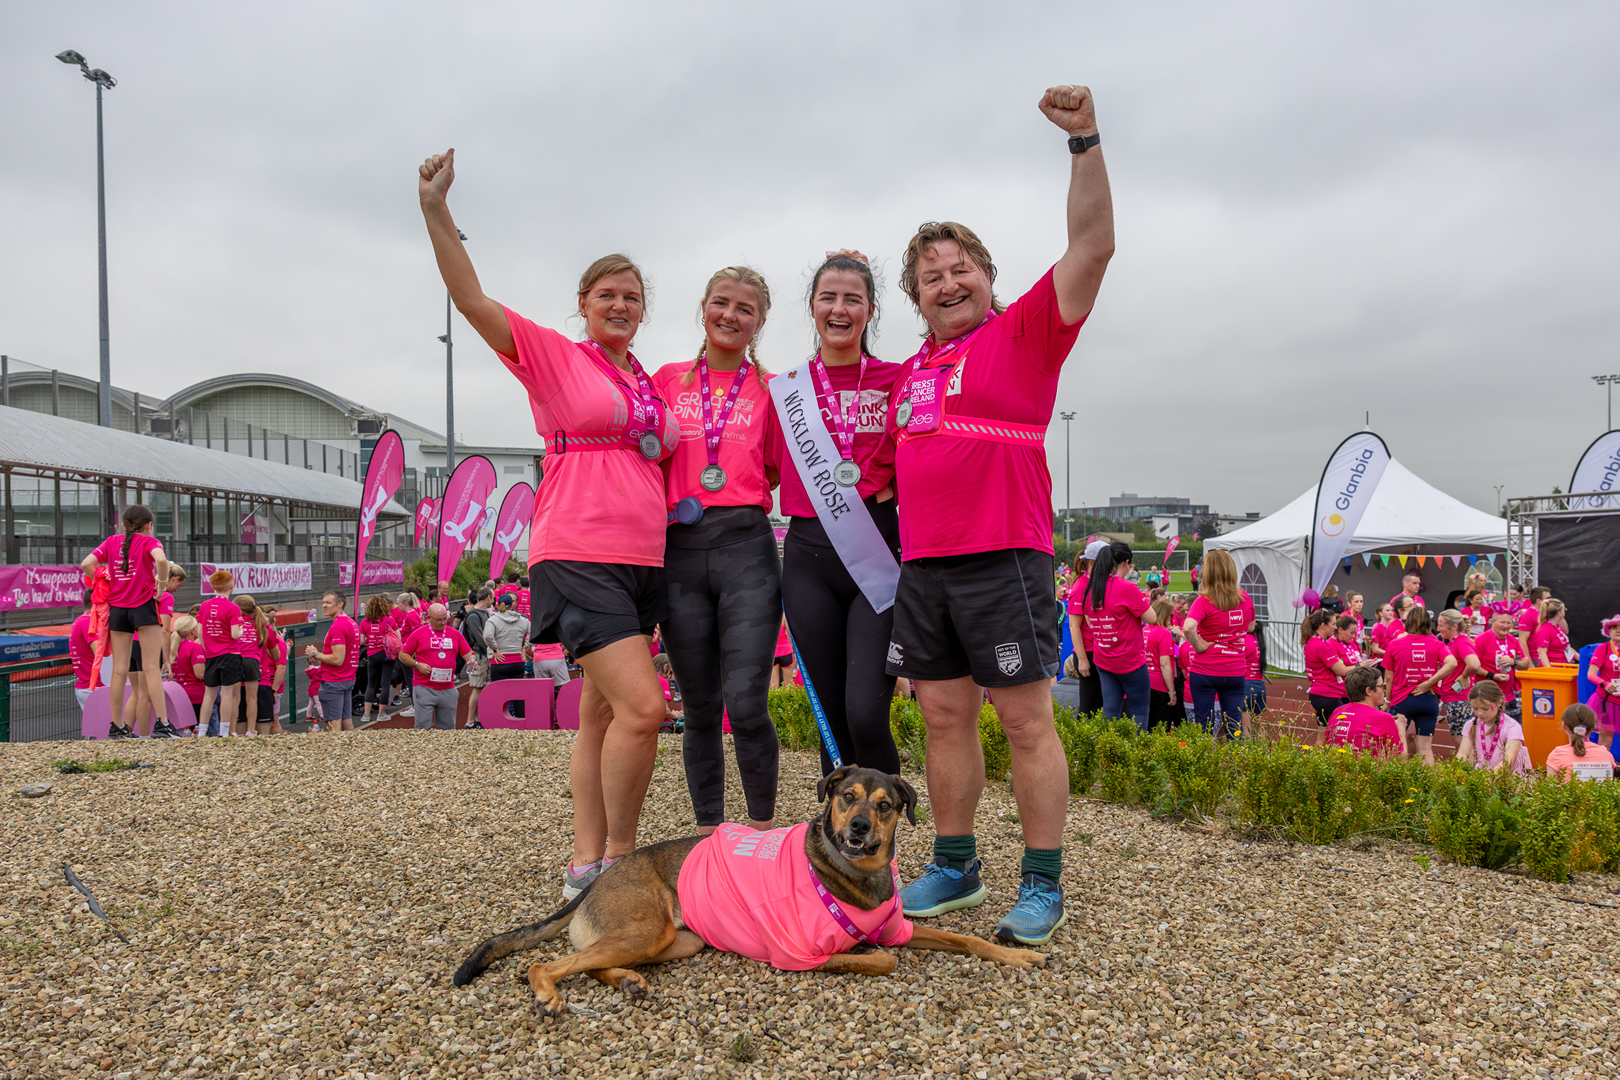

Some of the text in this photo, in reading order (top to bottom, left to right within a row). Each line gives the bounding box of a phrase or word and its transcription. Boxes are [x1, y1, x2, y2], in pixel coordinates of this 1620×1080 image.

[677, 392, 728, 409] GRA
[910, 393, 935, 403] RELAND
[674, 405, 703, 421] PIN
[855, 415, 884, 427] UN
[784, 390, 851, 520] WICKLOW ROSE
[1336, 449, 1374, 510] Glanbia
[1589, 447, 1620, 508] Ganbi
[42, 570, 80, 589] supposed
[248, 568, 272, 588] RUN
[31, 588, 53, 602] hard
